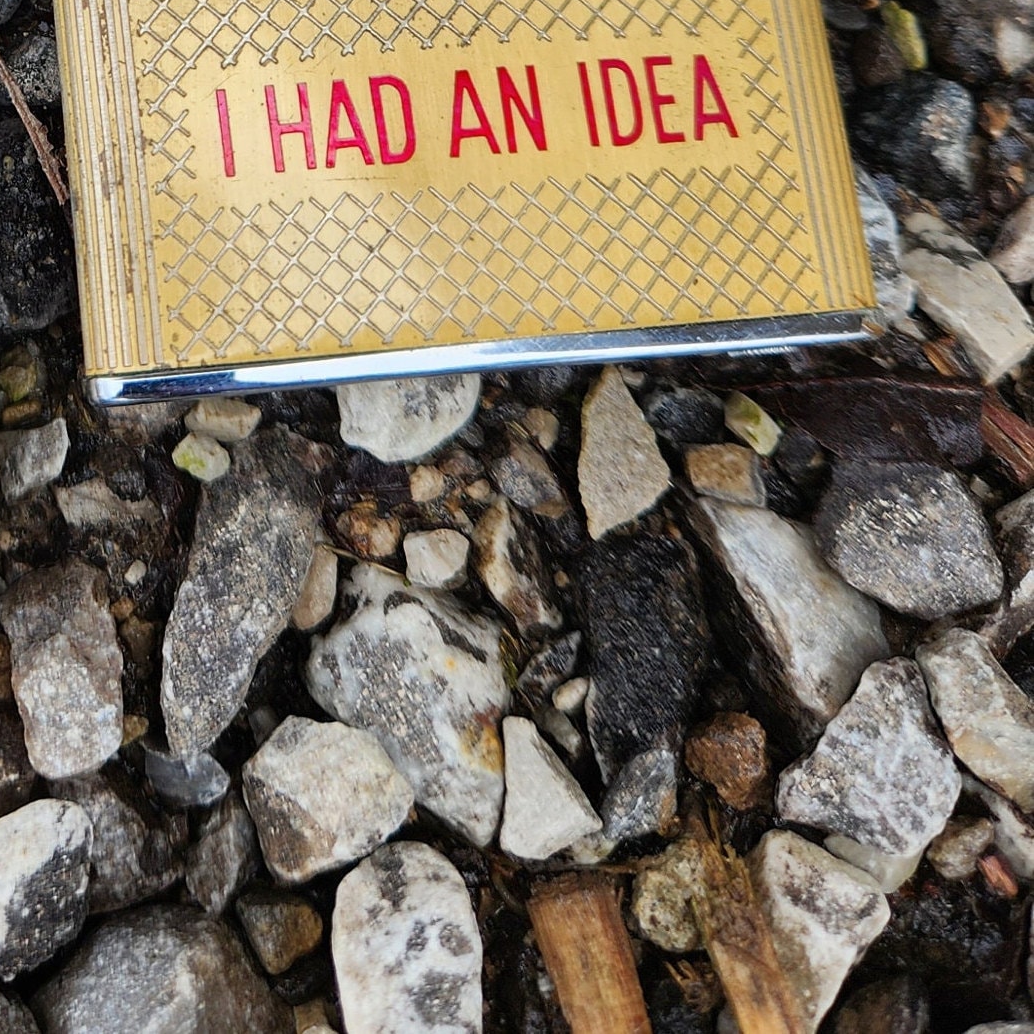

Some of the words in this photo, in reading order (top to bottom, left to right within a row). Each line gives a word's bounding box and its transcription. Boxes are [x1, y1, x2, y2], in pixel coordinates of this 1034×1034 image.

[215, 88, 236, 178] I
[265, 74, 417, 173] HAD
[449, 64, 549, 159] AN
[576, 53, 740, 148] IDEA
